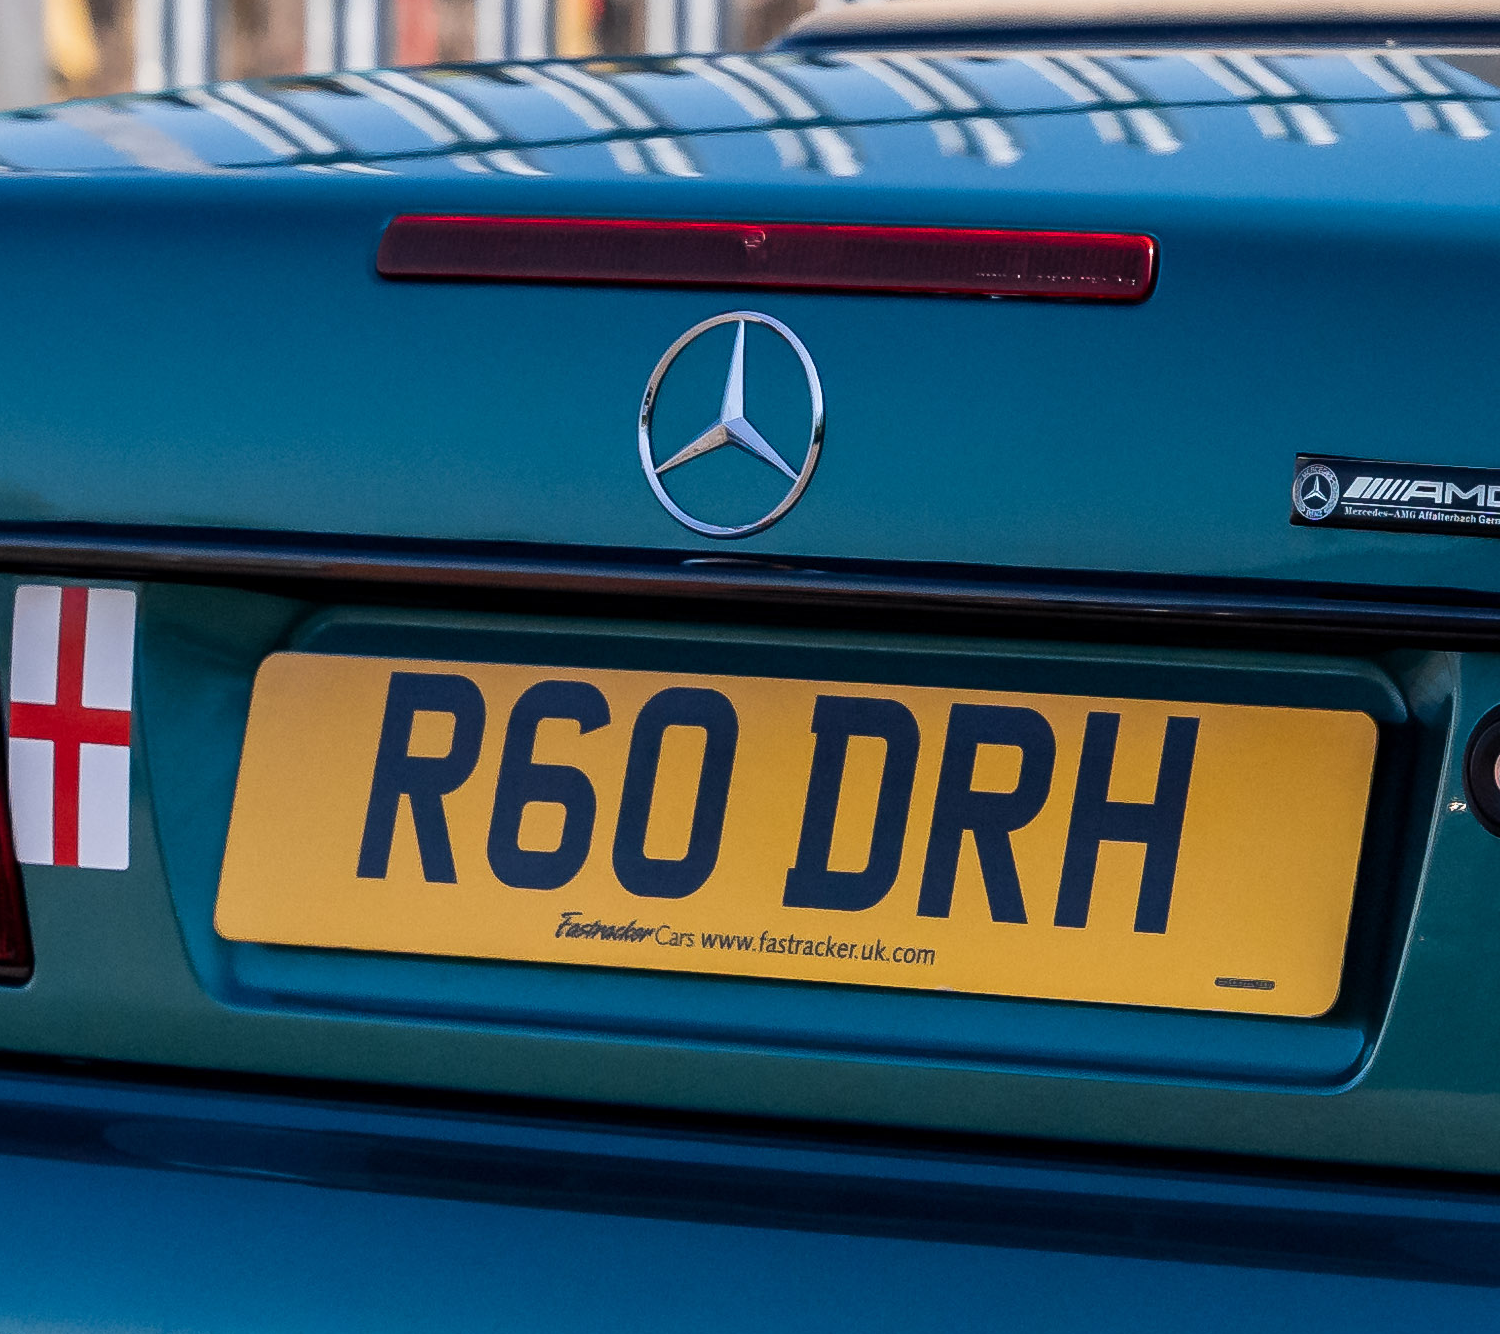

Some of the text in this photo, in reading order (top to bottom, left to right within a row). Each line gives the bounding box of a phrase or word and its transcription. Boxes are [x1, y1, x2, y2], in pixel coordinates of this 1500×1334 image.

[1418, 510, 1477, 524] Affalterbach
[355, 670, 1201, 936] R60 DRH
[655, 924, 696, 948] Cars
[701, 930, 937, 966] www.fastracker.uk.com
